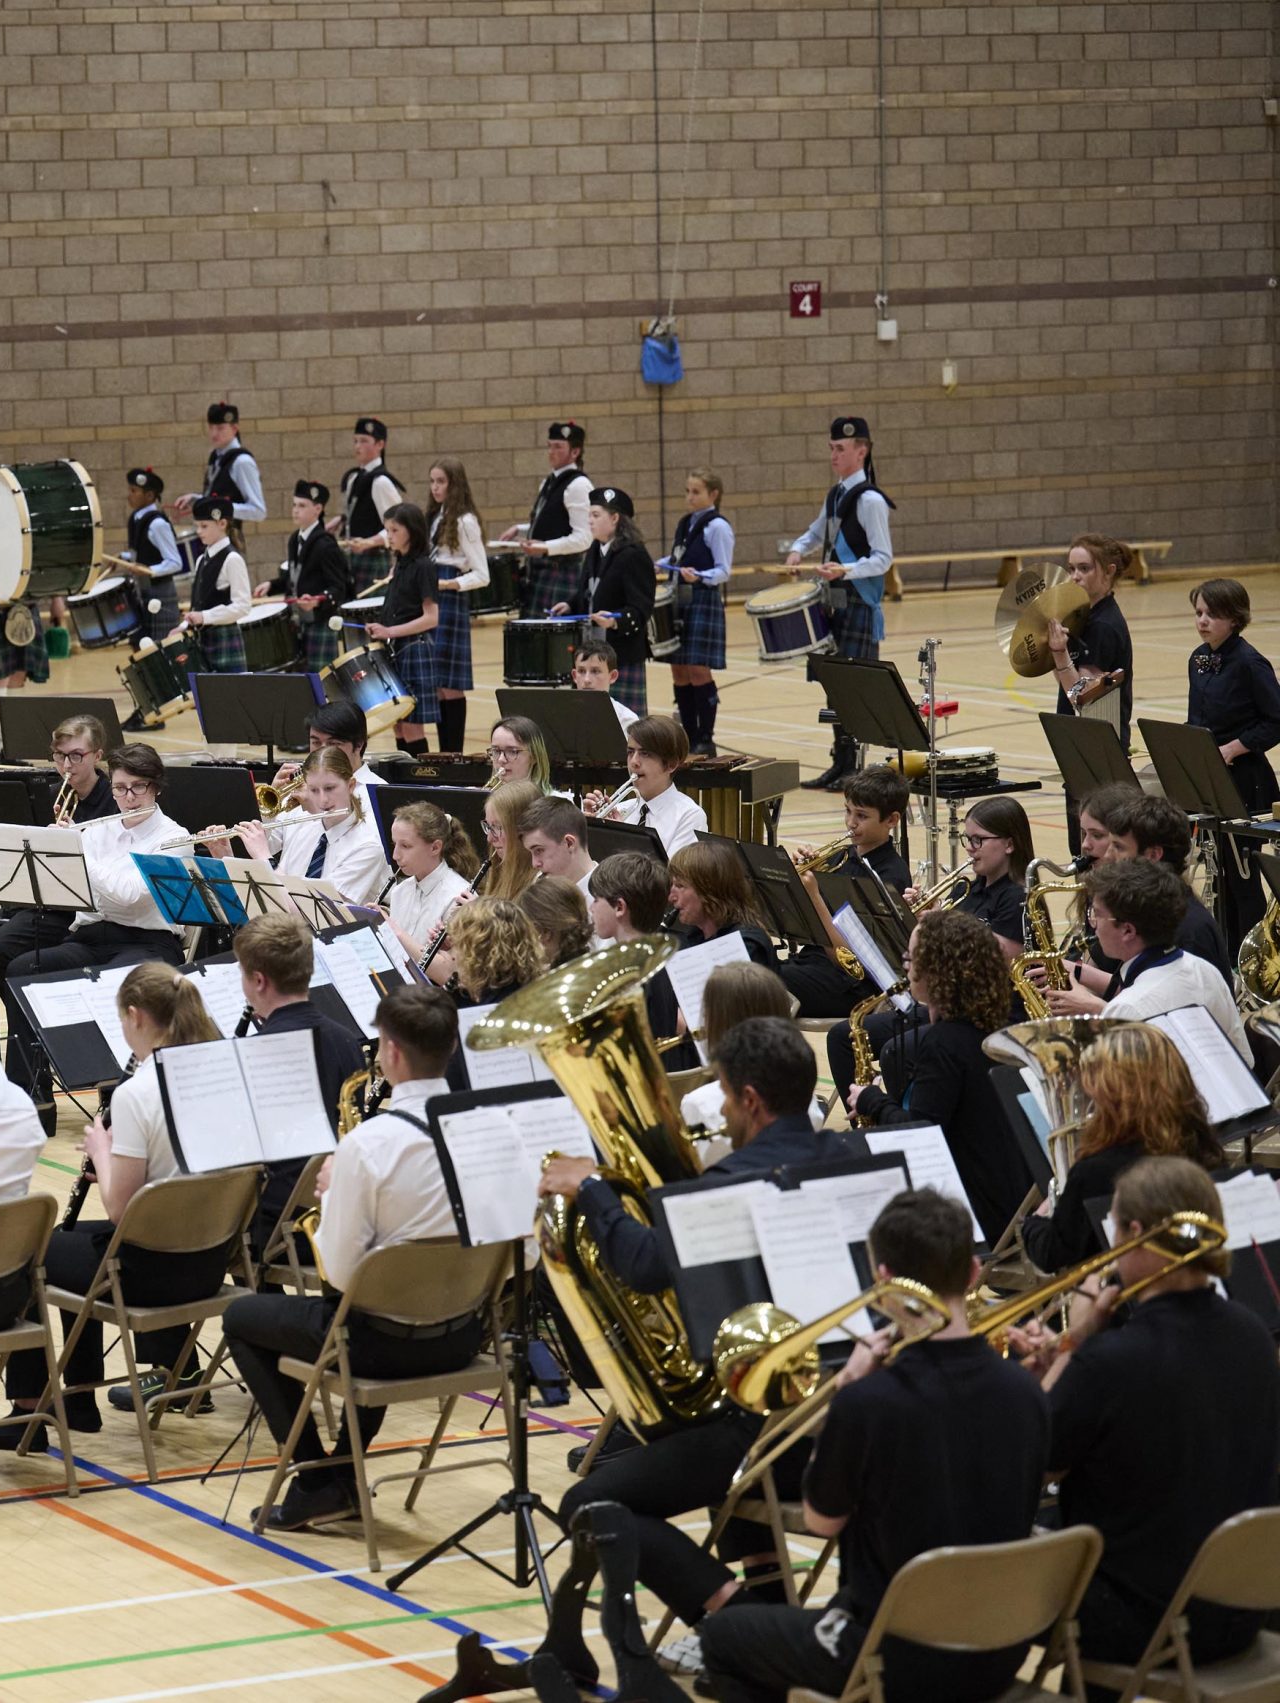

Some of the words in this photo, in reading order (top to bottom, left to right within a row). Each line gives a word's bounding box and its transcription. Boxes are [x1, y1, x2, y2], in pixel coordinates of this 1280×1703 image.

[792, 283, 818, 293] COURT
[799, 294, 813, 315] 4
[1015, 579, 1046, 606] SABIAN
[1024, 633, 1039, 663] SABIAN
